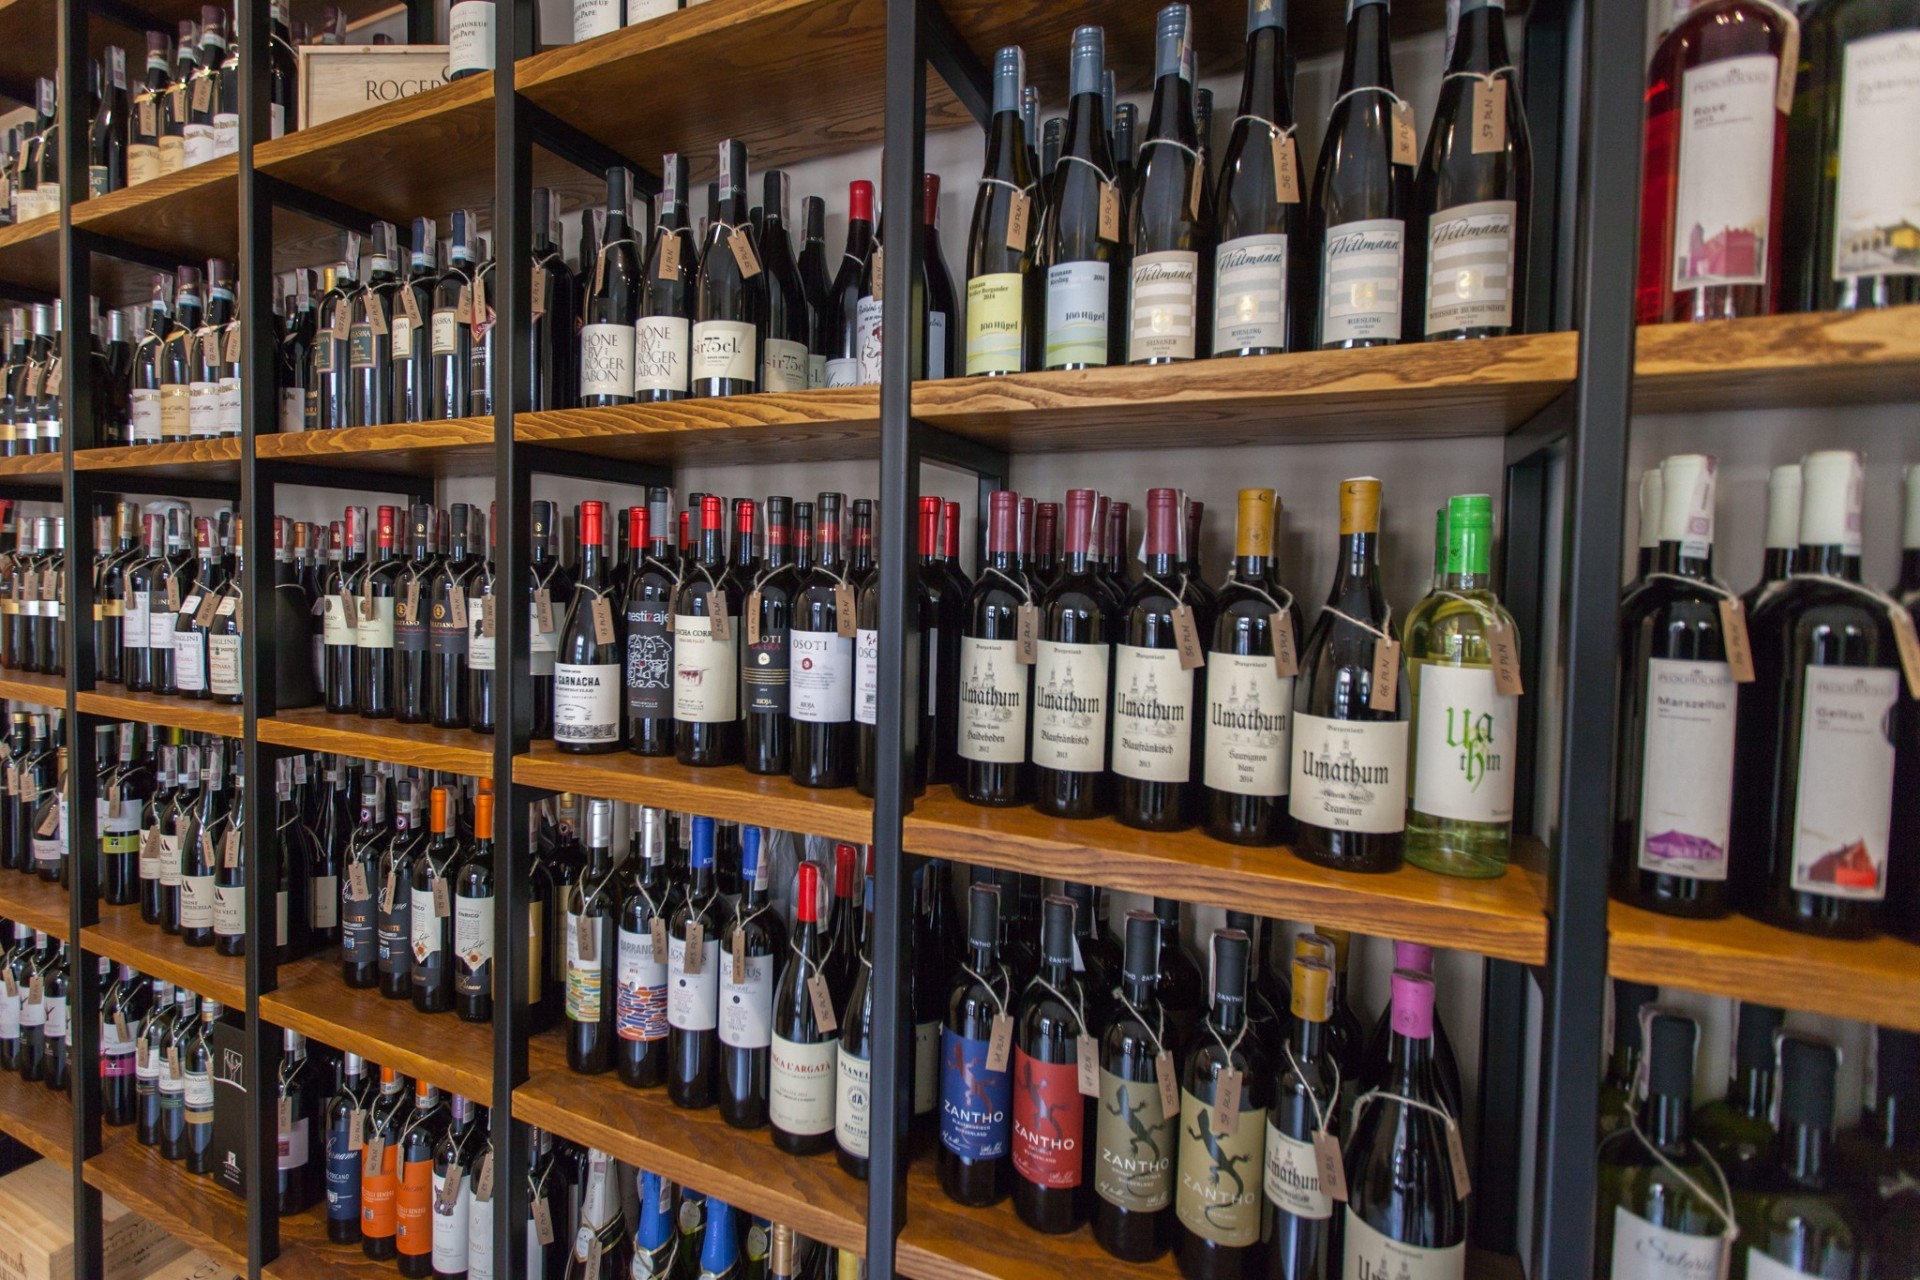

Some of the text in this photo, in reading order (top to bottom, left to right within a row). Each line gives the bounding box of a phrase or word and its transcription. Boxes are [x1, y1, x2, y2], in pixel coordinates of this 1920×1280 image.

[793, 638, 828, 651] OSOTI
[558, 676, 600, 687] GARNACHA
[961, 680, 1020, 712] Umathum
[1037, 686, 1100, 717] Umathum
[1118, 692, 1184, 726] Umathum
[1212, 703, 1286, 736] Umathum
[1303, 751, 1389, 789] Umathum
[944, 1099, 1004, 1124] ZANTHO
[1014, 1120, 1075, 1151] ZANTHO
[1103, 1148, 1169, 1173] ZANTHO
[1182, 1173, 1255, 1205] ZANTHO
